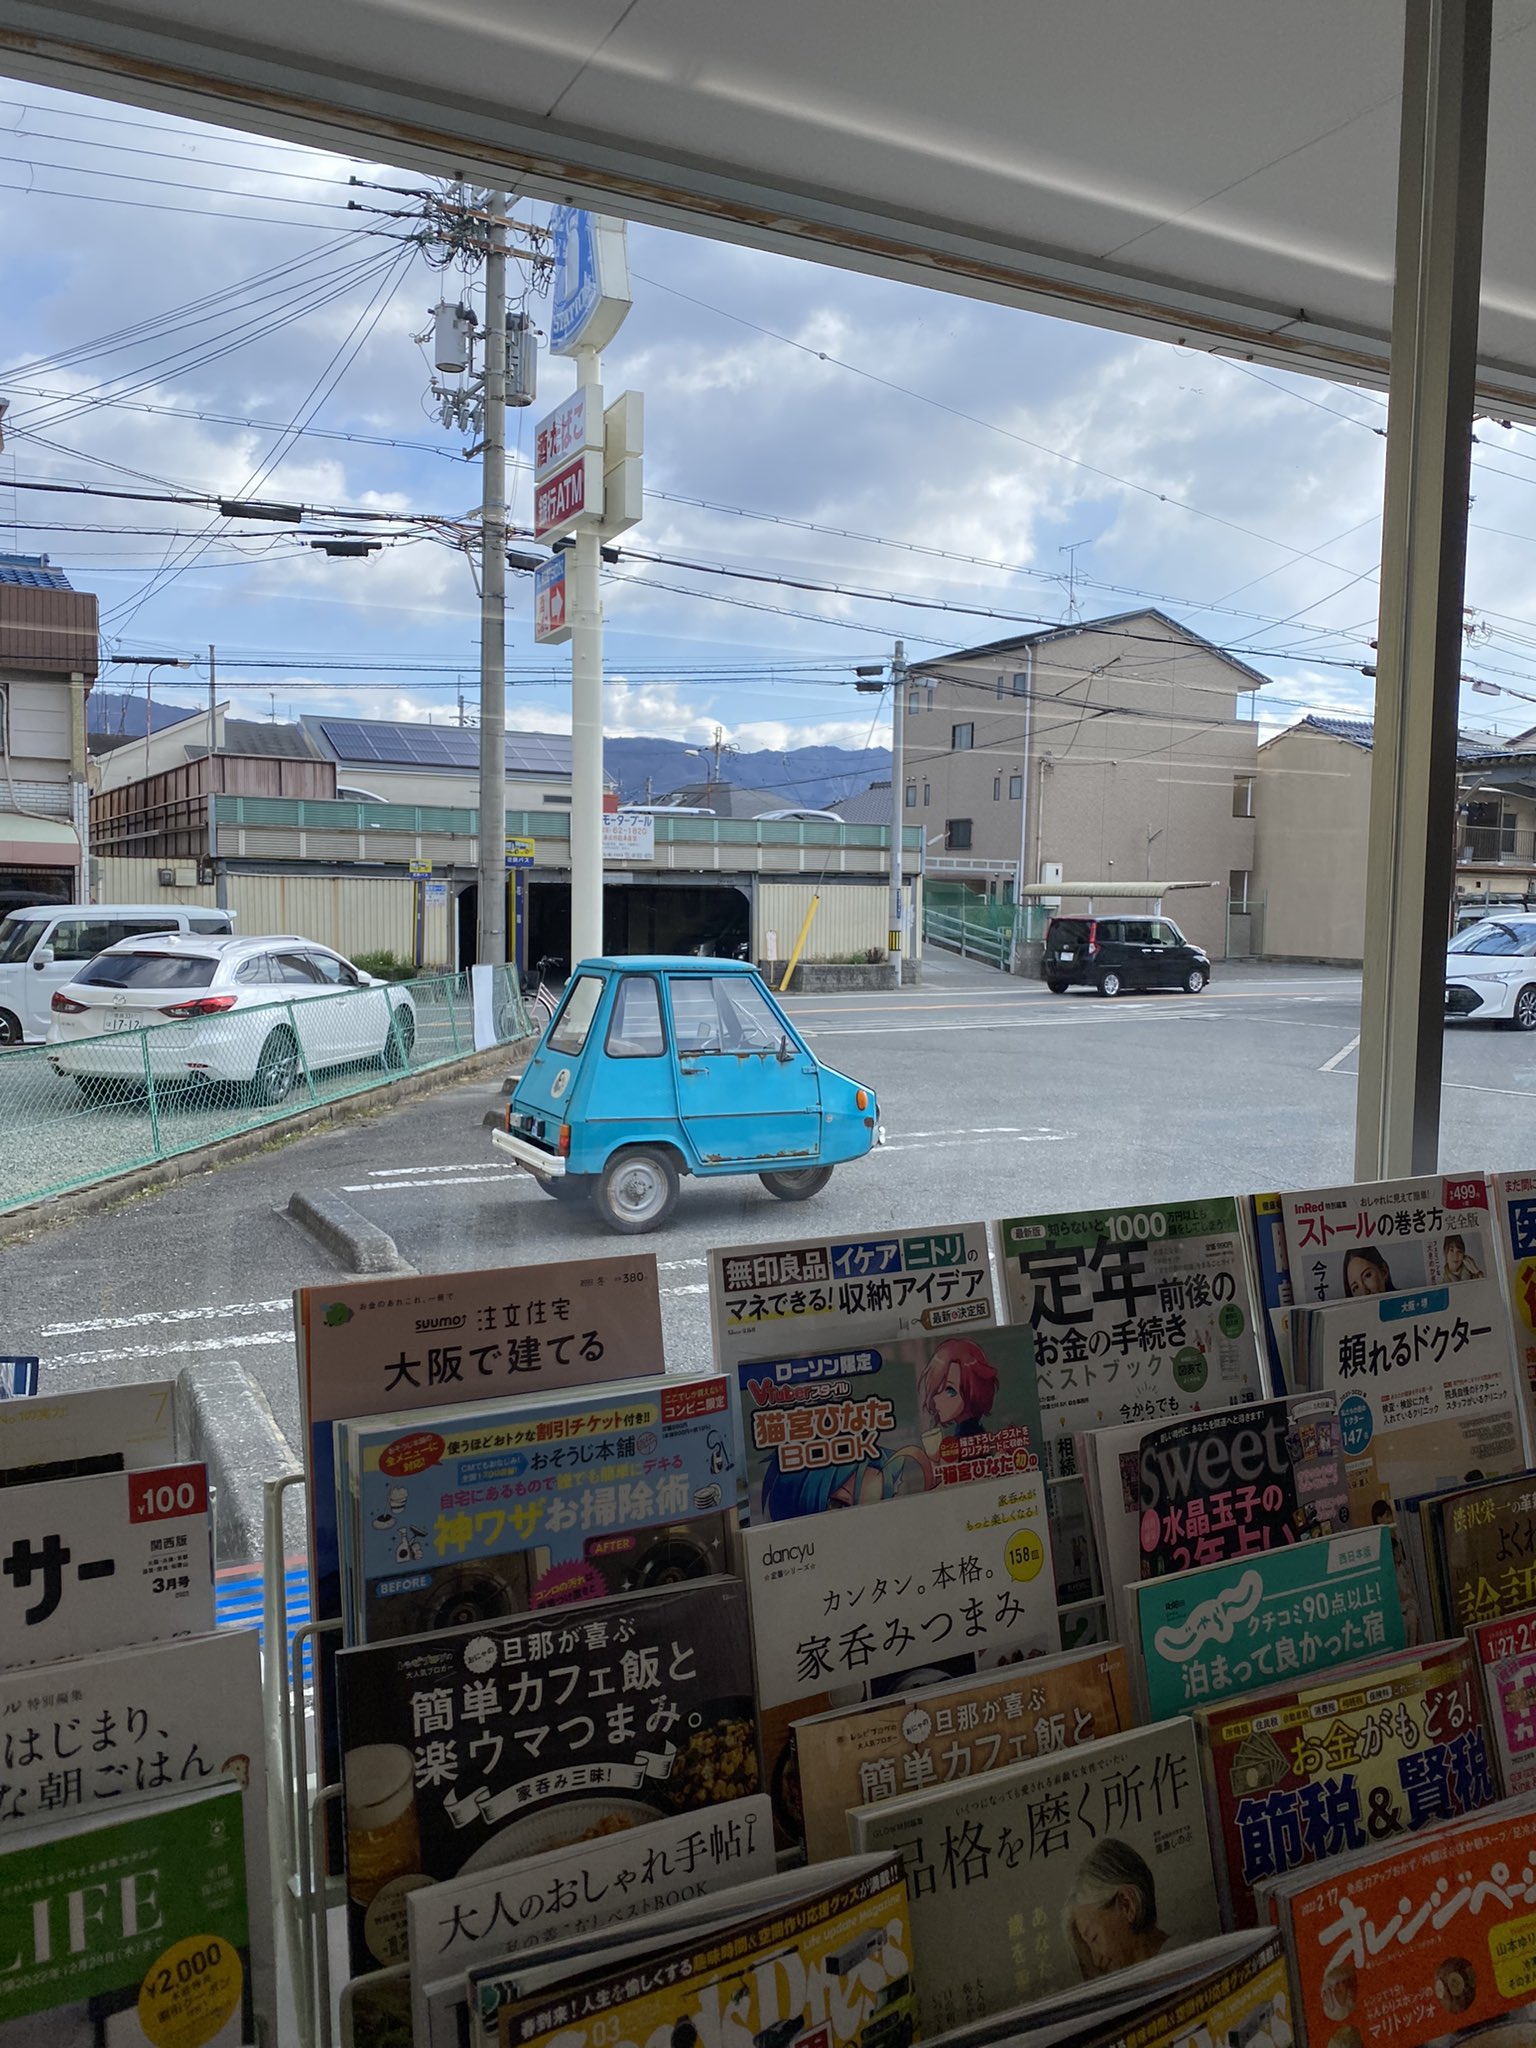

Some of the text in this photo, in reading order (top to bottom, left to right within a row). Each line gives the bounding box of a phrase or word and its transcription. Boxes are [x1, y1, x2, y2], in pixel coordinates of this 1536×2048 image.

[1294, 1201, 1325, 1215] InRed
[1297, 1206, 1444, 1248] ストールの巻き方
[1445, 1211, 1480, 1231] 完全版
[1014, 1228, 1042, 1240] 最新版
[726, 1251, 827, 1291] 無印良品
[835, 1243, 898, 1275] イケア
[1019, 1235, 1157, 1331] 定年
[1158, 1271, 1236, 1314] 前後の
[476, 1297, 572, 1332] 注文住宅
[384, 1329, 605, 1393] 大阪で建てる
[1033, 1313, 1187, 1367] お金の手続き
[1338, 1316, 1493, 1380] 頼れるドクター
[775, 1353, 873, 1382] ローソン限定
[1037, 1353, 1162, 1390] ベストブック
[665, 1395, 726, 1419] コンビニ限定
[755, 1398, 894, 1446] 猫宮ひなた
[1118, 1395, 1180, 1418] 今からでも
[530, 1434, 636, 1471] おそうじ本舗
[779, 1431, 880, 1472] BOOK
[1056, 1437, 1077, 1476] 相続
[432, 1472, 690, 1557] 神ワザお掃除術
[1162, 1484, 1284, 1547] 水晶玉子の
[594, 1538, 630, 1553] AFTER
[761, 1541, 816, 1568] dancyu
[2, 1533, 116, 1626] サー
[151, 1575, 191, 1594] 3月号
[380, 1575, 427, 1594] BEFORE
[822, 1554, 995, 1617] カンタン。本格。
[501, 1616, 636, 1667] 旦那が喜ぶ
[795, 1590, 1026, 1683] 家呑みつまみ
[1181, 1609, 1387, 1699] 泊まって良かった宿
[409, 1640, 698, 1738] 簡単カフェ飯と
[934, 1686, 1048, 1738] 旦那が喜ぶ
[412, 1692, 703, 1790] 楽ウマつまみ。
[1290, 1680, 1473, 1775] お金がもどる!
[892, 1751, 1190, 1900] 品格を磨く所作
